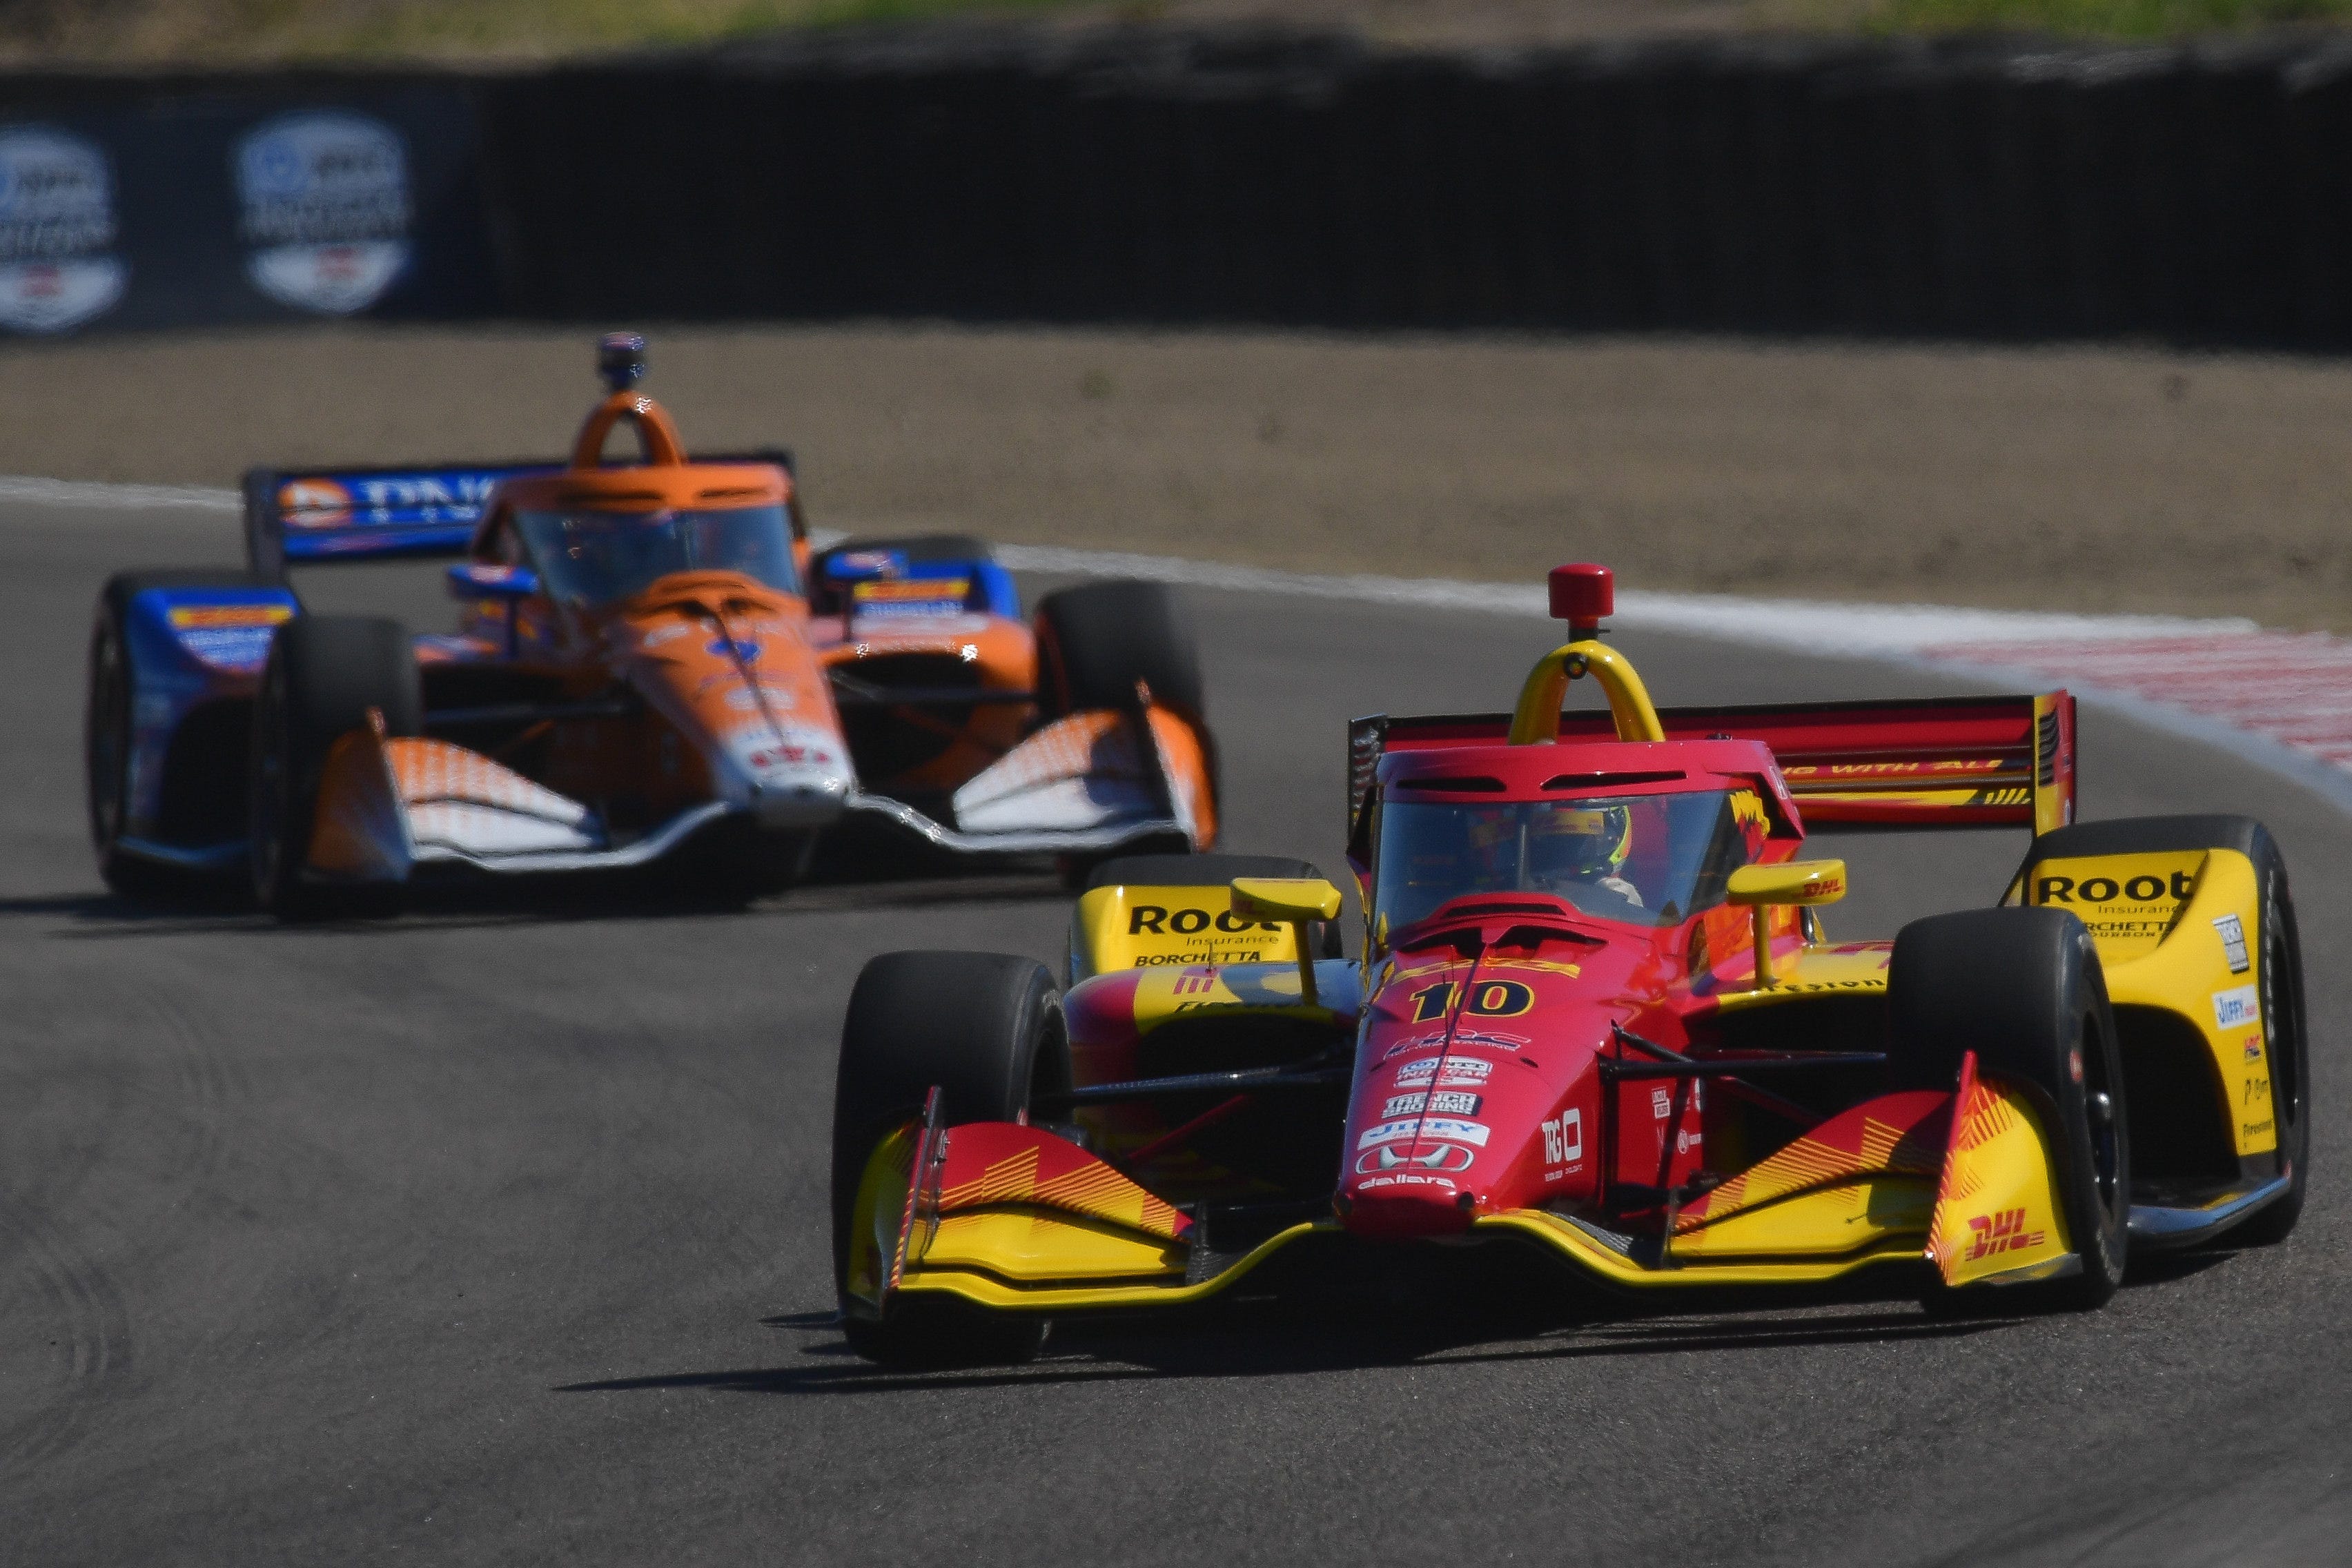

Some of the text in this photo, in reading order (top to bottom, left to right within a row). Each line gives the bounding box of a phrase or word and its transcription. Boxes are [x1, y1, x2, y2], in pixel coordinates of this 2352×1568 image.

[1803, 879, 1842, 897] DHL
[1187, 935, 1280, 946] Insurance
[1135, 952, 1261, 966] BORCHETTA
[1409, 980, 1536, 1023] 10
[1358, 1175, 1456, 1190] dallara
[1966, 1208, 2039, 1261] DHL
